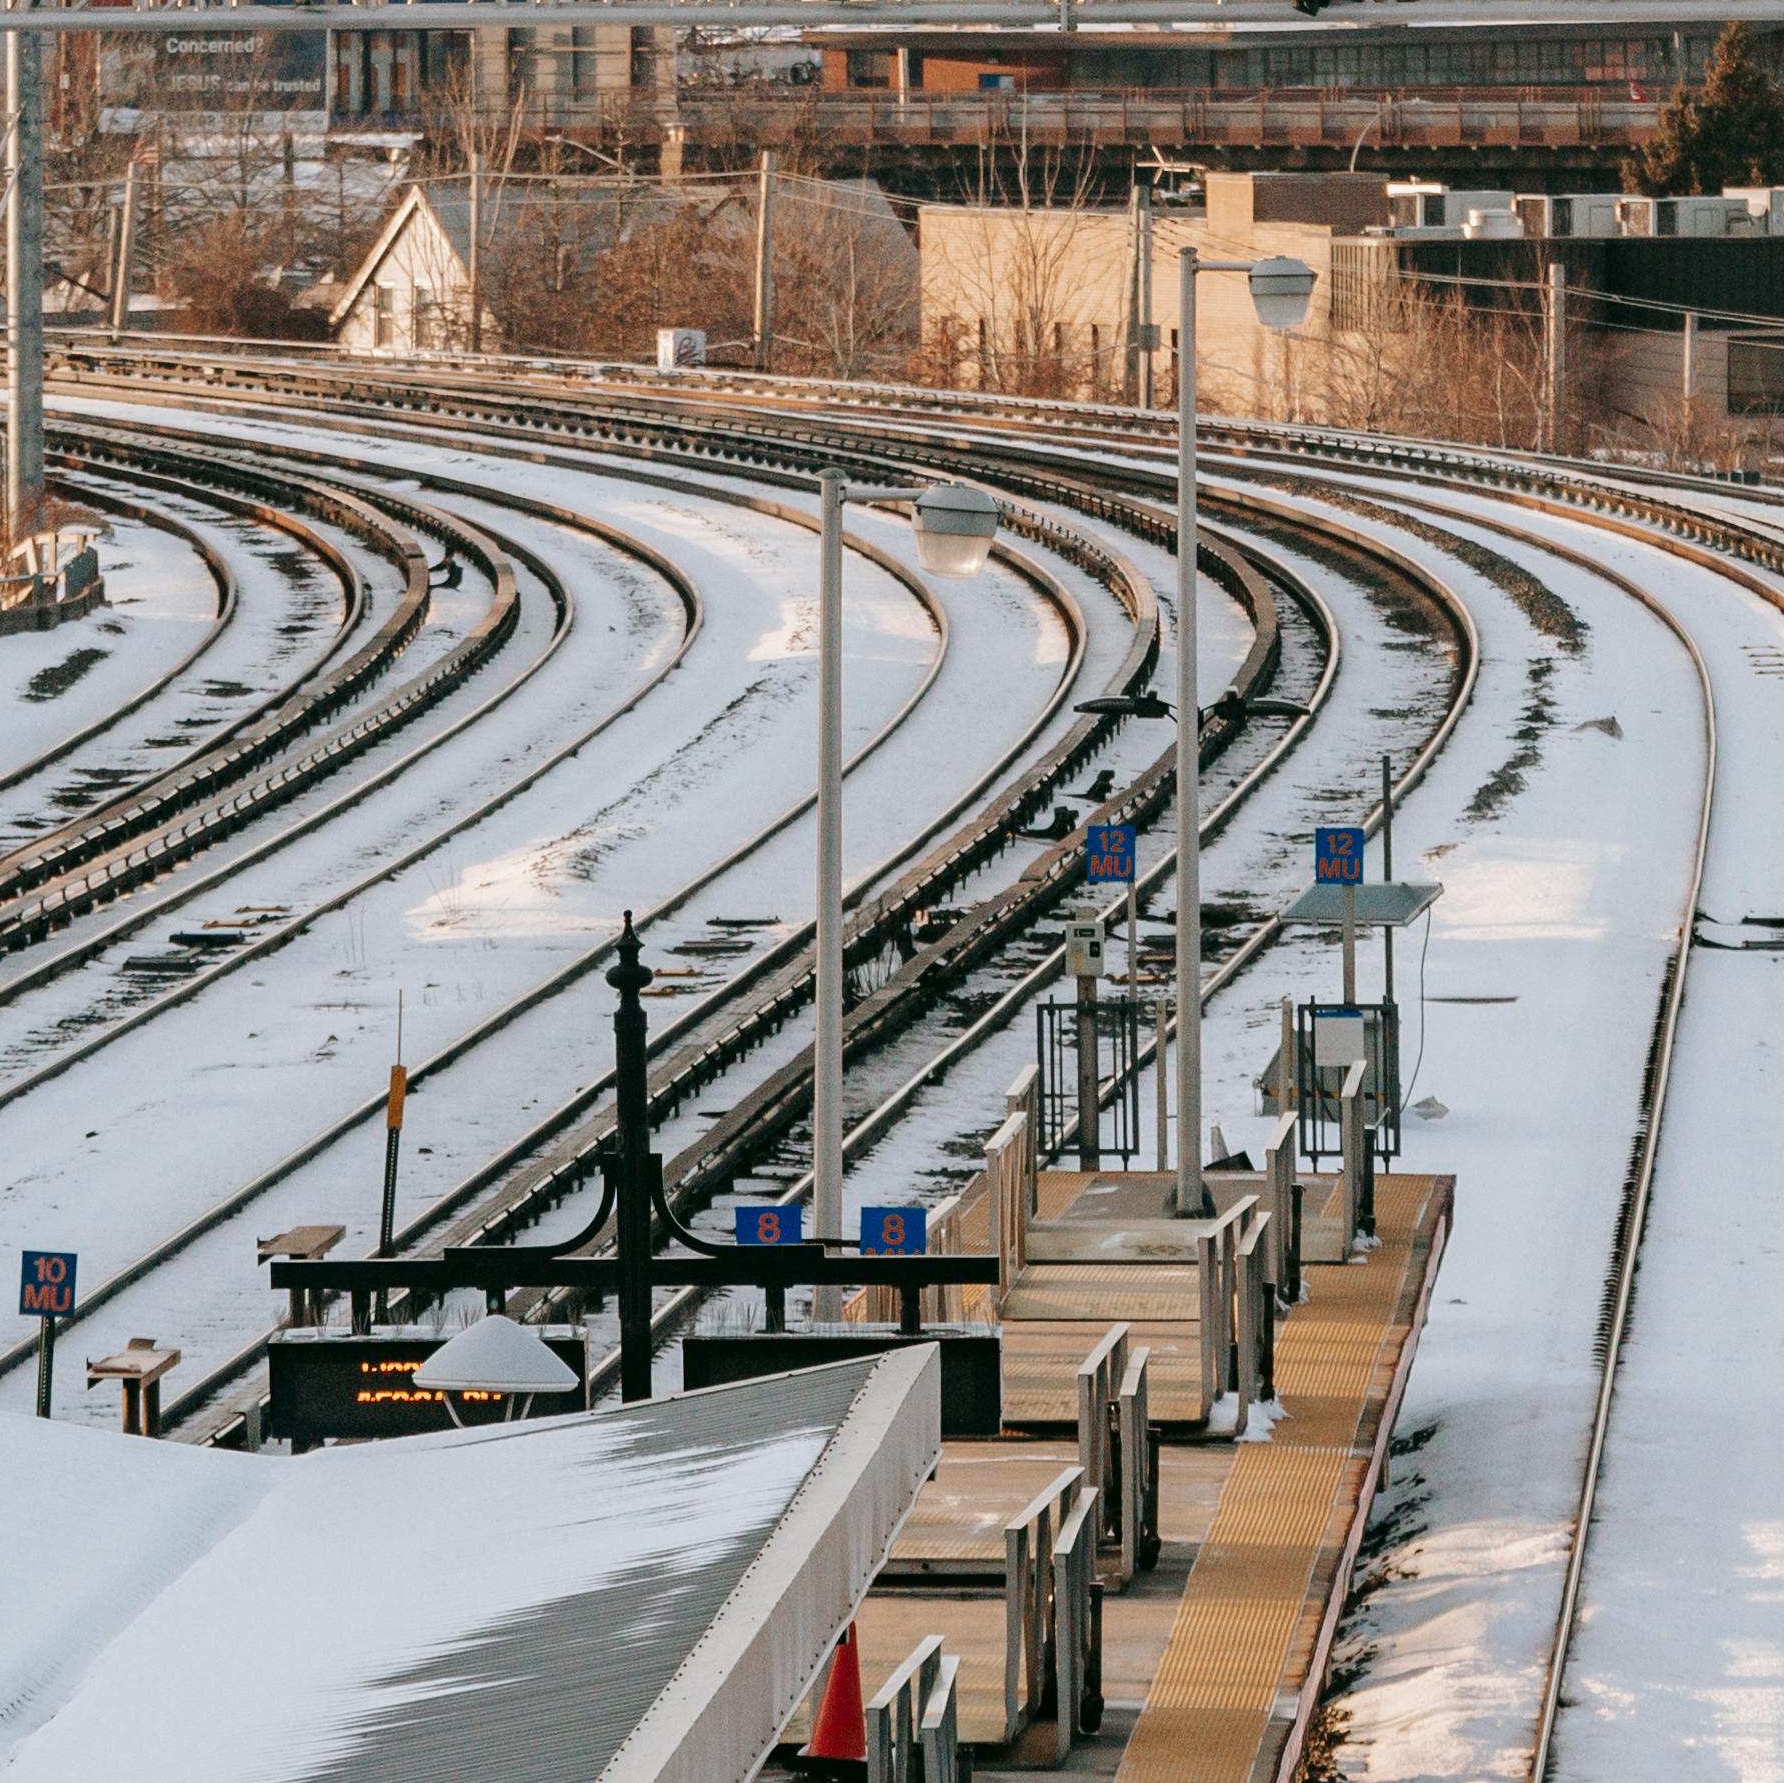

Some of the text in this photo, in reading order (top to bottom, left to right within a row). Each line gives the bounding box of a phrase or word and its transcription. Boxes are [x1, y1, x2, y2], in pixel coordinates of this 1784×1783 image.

[167, 37, 265, 54] Concerned?
[1099, 830, 1126, 853] 12
[1326, 832, 1354, 855] 12
[1090, 855, 1132, 878] MU
[1318, 857, 1360, 880] MU
[758, 1212, 781, 1243] 8
[881, 1214, 906, 1245] 8
[33, 1255, 66, 1284] 10
[24, 1283, 71, 1312] MU
